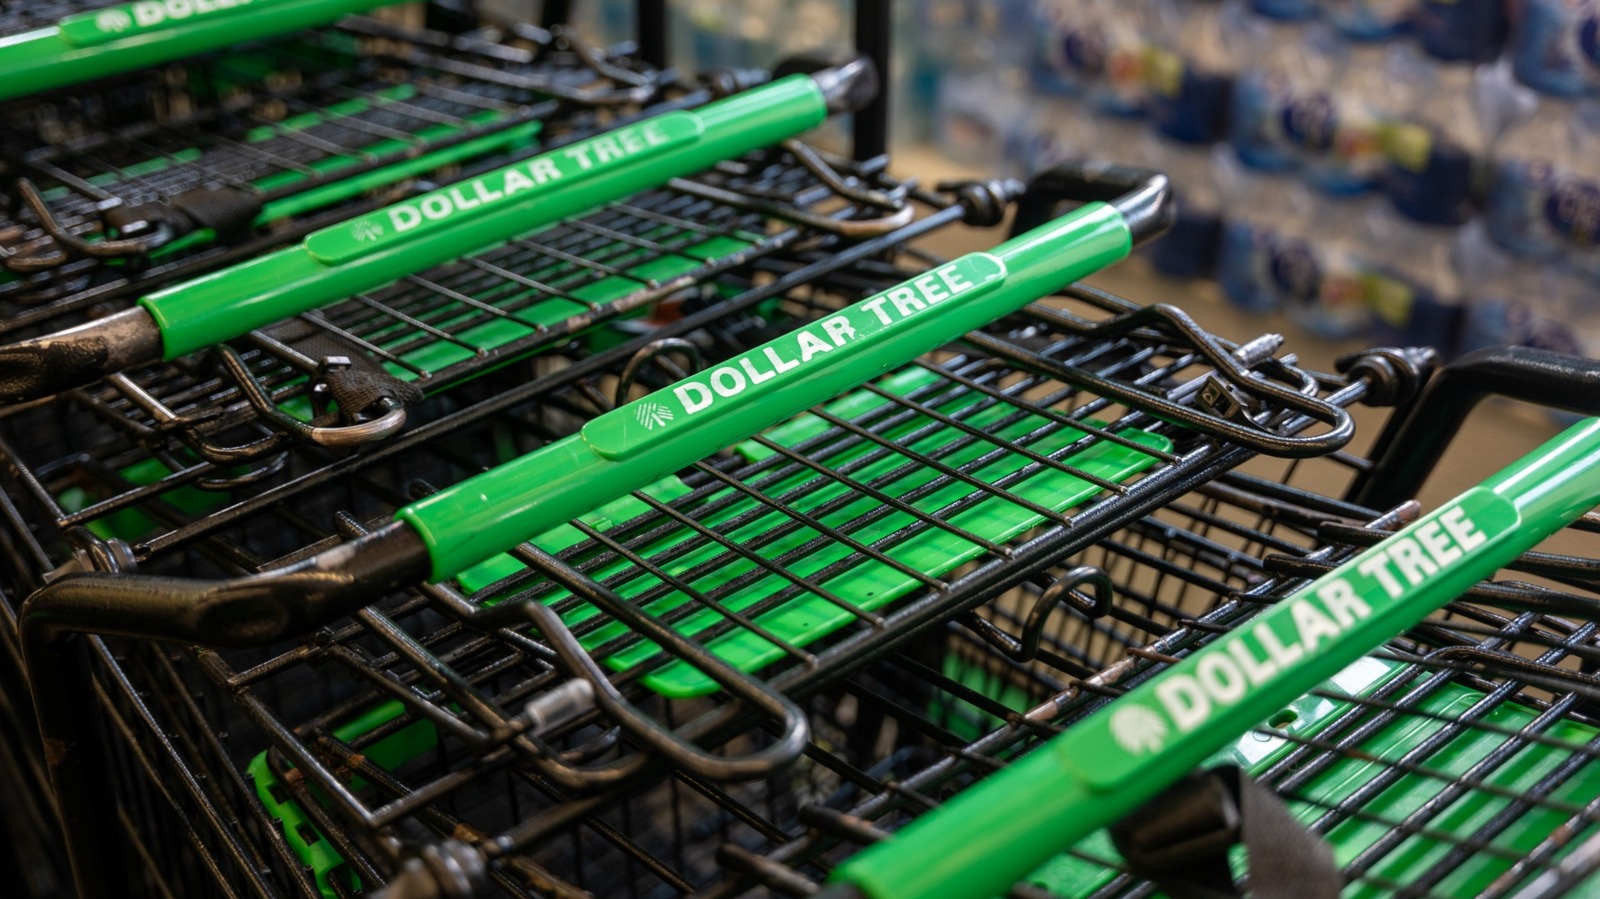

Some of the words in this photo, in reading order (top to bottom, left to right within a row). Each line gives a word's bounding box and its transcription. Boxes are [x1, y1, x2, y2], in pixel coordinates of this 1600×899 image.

[387, 157, 563, 233] DOLLAR
[564, 121, 670, 170] TREE
[672, 315, 856, 415] DOLLAR
[861, 264, 974, 326] TREE
[1155, 577, 1372, 733] DOLLAR
[1358, 505, 1488, 599] TREE
